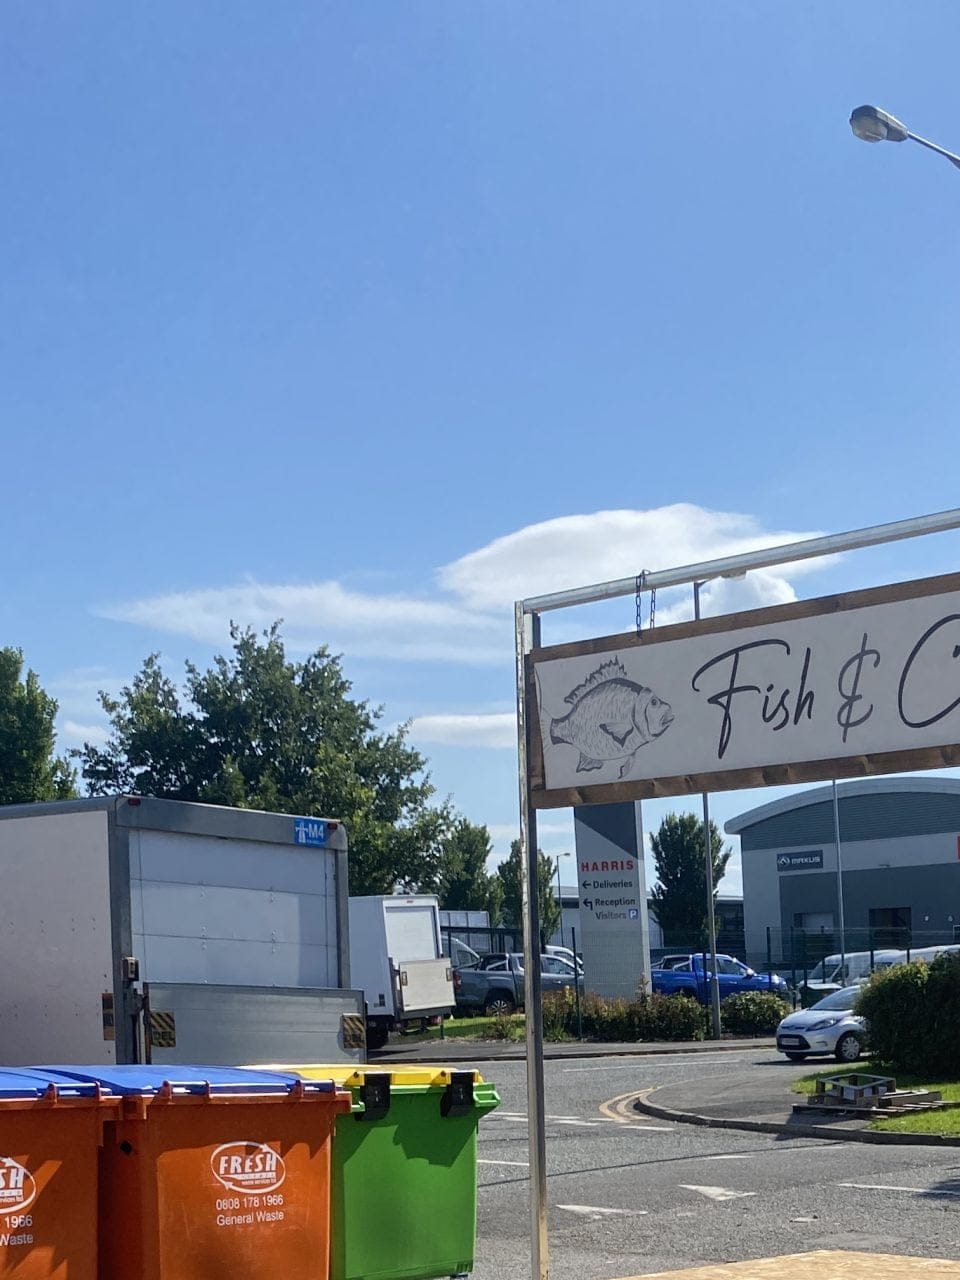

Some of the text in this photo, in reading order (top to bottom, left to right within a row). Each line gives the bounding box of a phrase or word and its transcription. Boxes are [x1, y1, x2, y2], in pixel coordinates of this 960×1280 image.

[691, 638, 815, 760] Fish
[836, 632, 881, 744] &
[308, 823, 324, 839] M4
[581, 860, 634, 872] HARRIS
[593, 880, 633, 889] Deliveries
[595, 897, 636, 907] Reception
[595, 911, 627, 920] Visitors
[219, 1152, 277, 1175] FRESH
[215, 1194, 284, 1211] 0808 178 1966
[4, 1214, 33, 1229] 1966
[216, 1210, 285, 1226] General Waste
[0, 1232, 34, 1246] Waste
